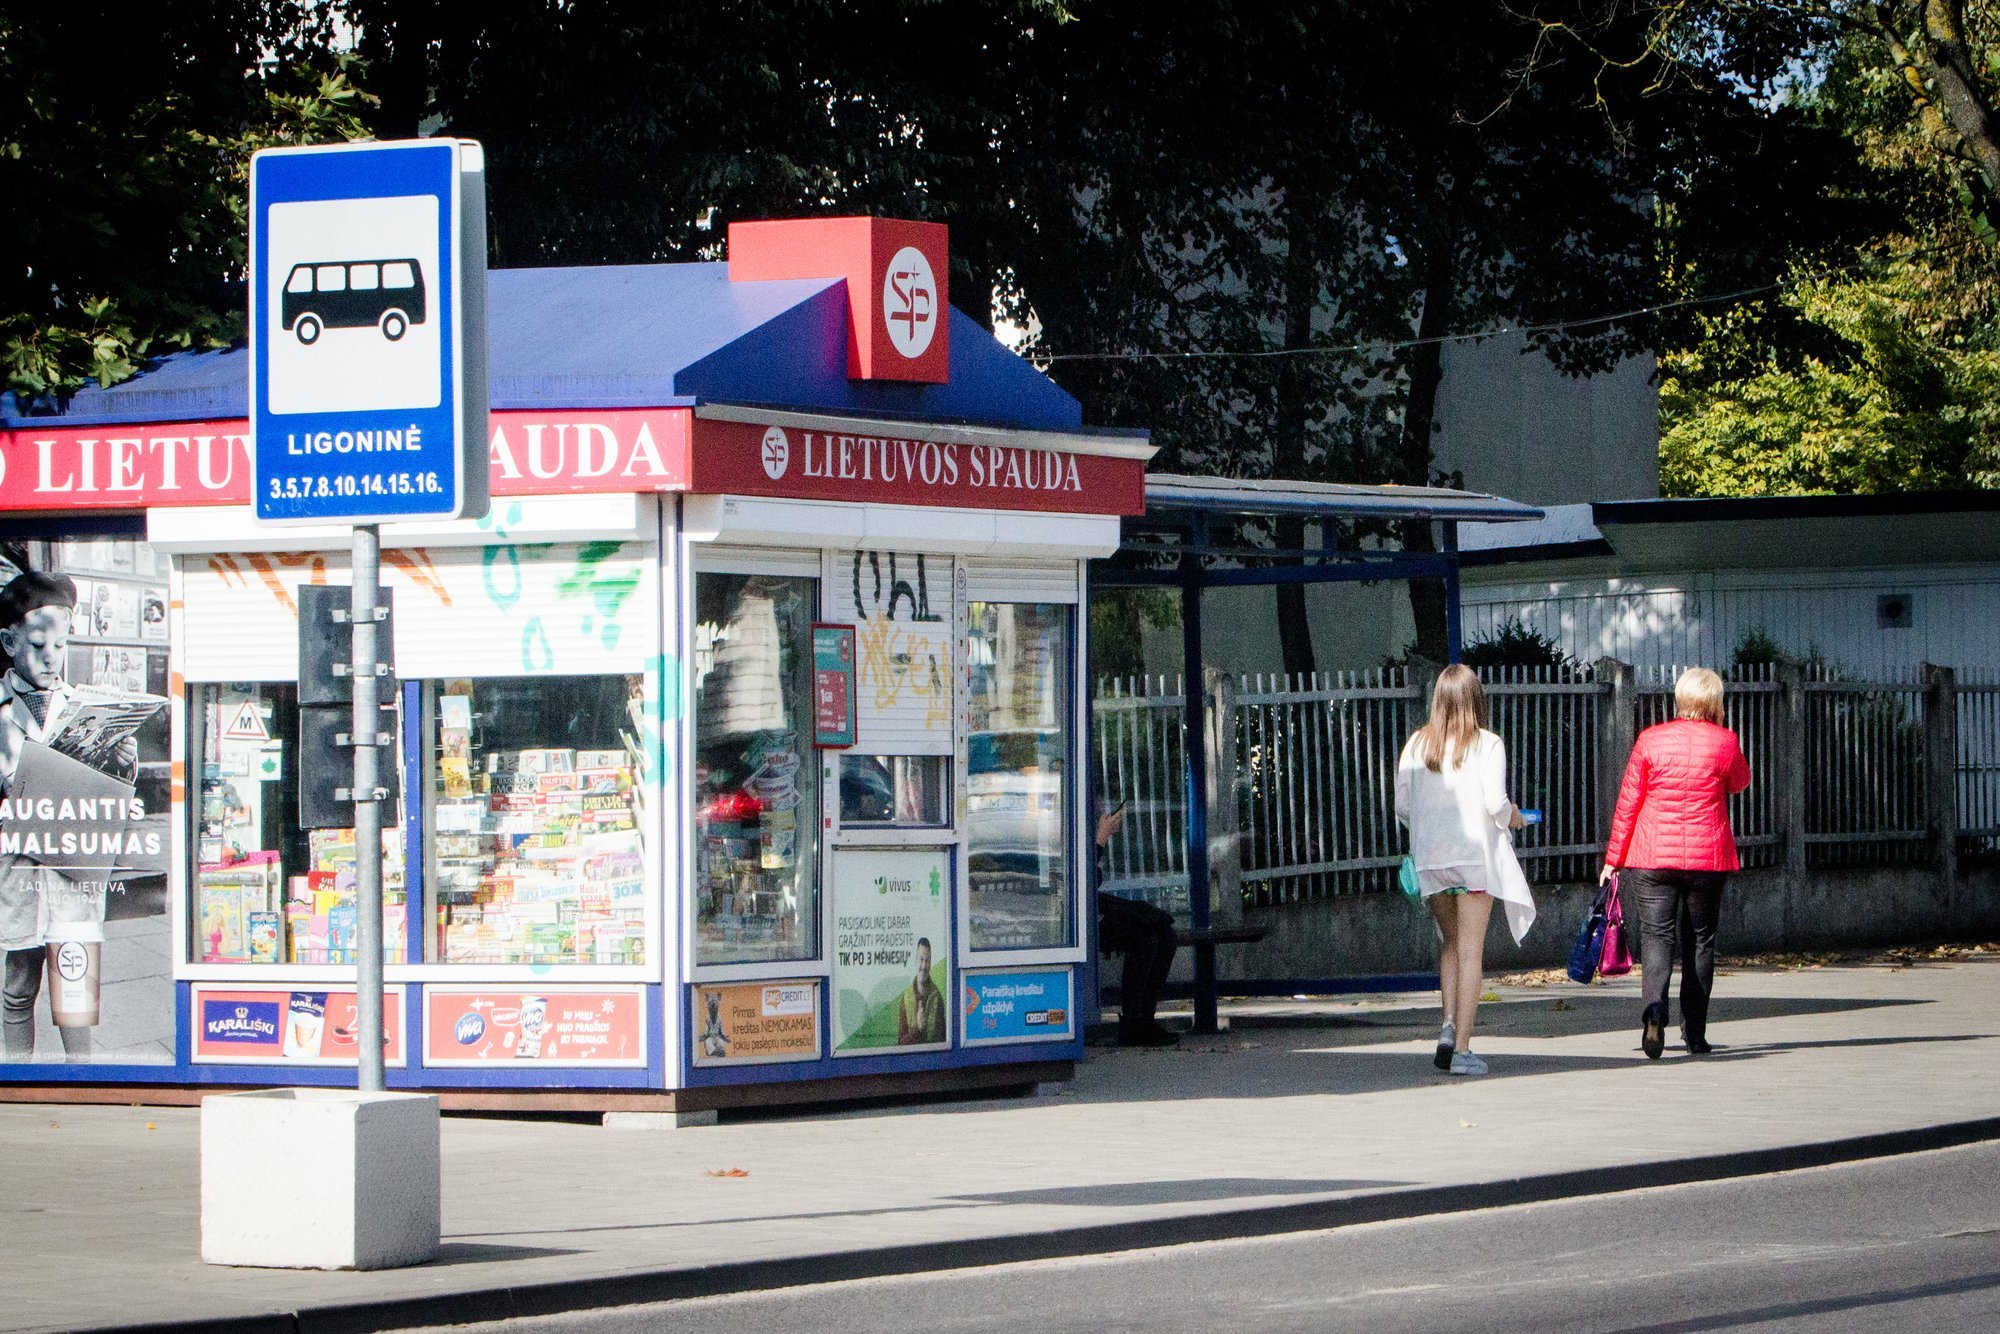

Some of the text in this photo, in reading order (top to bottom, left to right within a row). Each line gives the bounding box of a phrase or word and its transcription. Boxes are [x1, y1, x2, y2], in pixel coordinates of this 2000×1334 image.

[288, 424, 422, 455] LIGONINĖ
[490, 421, 669, 480] AUDA
[803, 433, 959, 485] LIETUVOS
[970, 445, 1083, 492] SPAUDA
[270, 472, 443, 499] 3.5.7.8.10.14.15.16.
[240, 716, 252, 729] M
[0, 798, 145, 820] AUGANTIS
[0, 832, 161, 855] MALSUMAS
[18, 879, 126, 896] ŽADINA LIETUVĄ
[888, 916, 911, 930] DABAR
[839, 952, 851, 966] TIK
[853, 952, 864, 966] PO
[866, 952, 872, 966] 3
[732, 1006, 756, 1019] Pirmas
[208, 1018, 275, 1035] KARALIŠKI
[733, 1022, 760, 1035] kreditas
